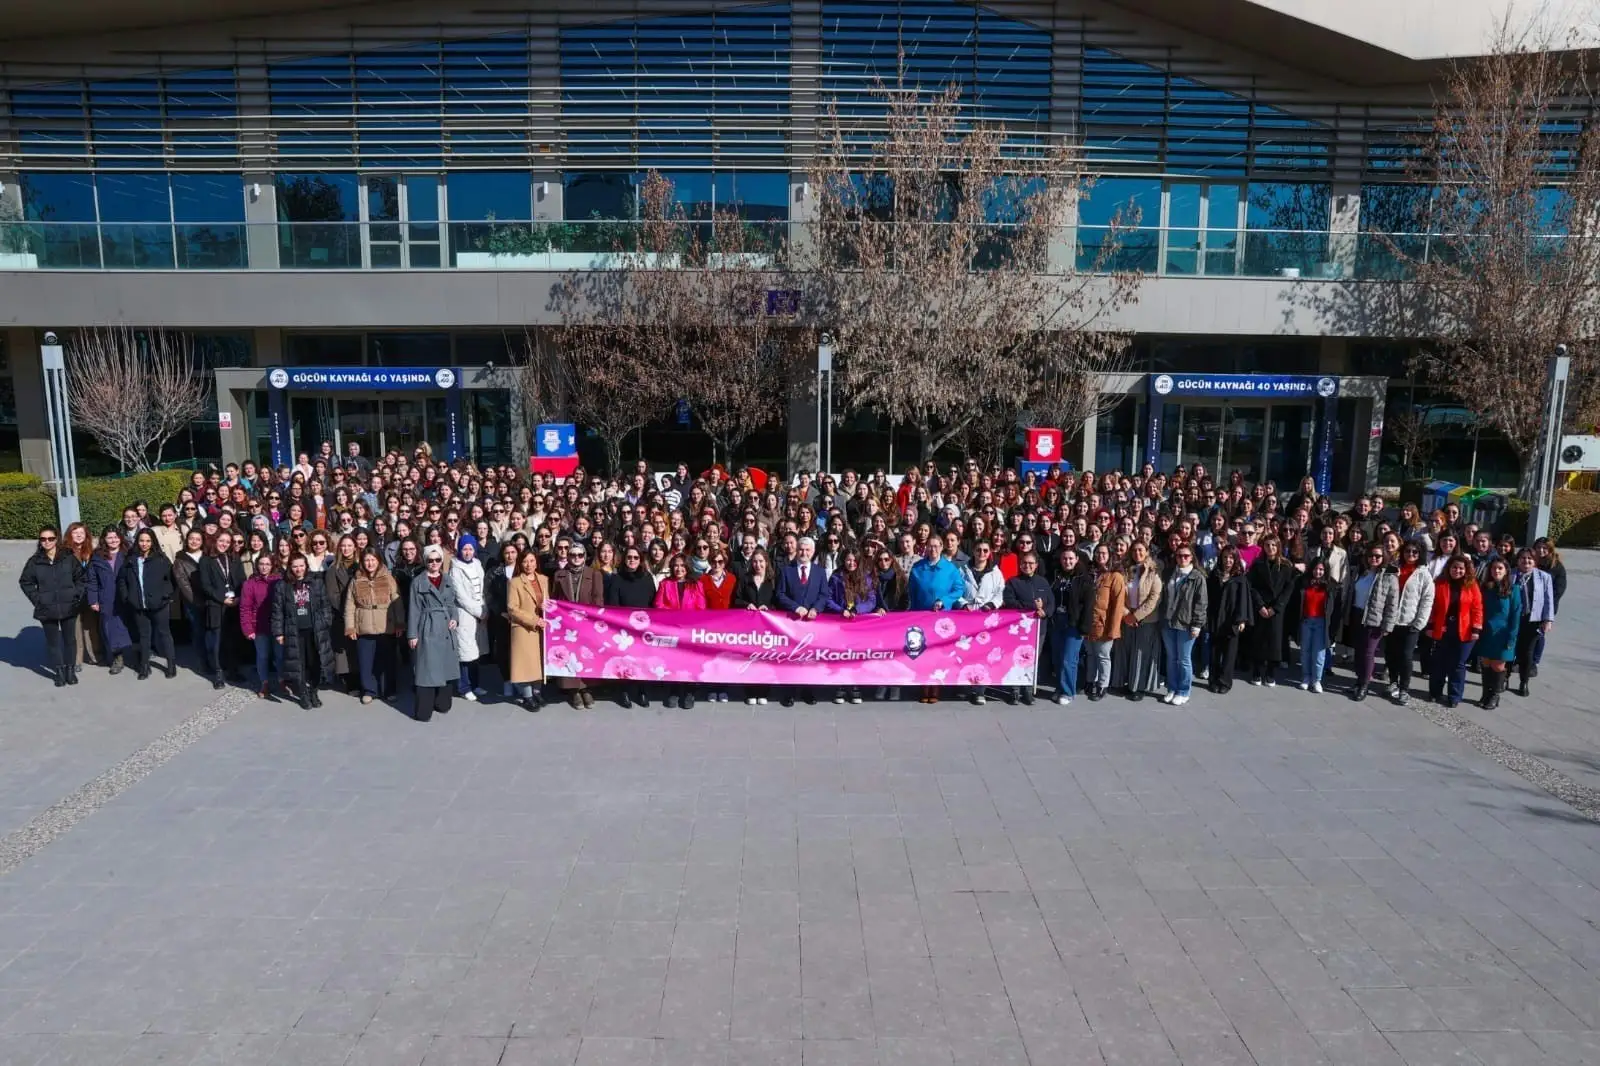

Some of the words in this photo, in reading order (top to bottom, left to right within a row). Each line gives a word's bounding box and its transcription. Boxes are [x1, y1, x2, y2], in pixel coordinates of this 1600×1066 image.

[293, 373, 327, 383] GÜCÜN
[330, 373, 371, 383] KAYNAĞI
[374, 374, 387, 383] 40
[390, 374, 431, 384] YAŞINDA
[1178, 379, 1211, 390] GÜCÜN
[1214, 381, 1254, 391] KAYNAĞI
[1257, 382, 1270, 391] 40
[1273, 383, 1313, 393] YAŞINDA
[691, 628, 789, 649] Havacılığın
[738, 632, 815, 674] güçlü
[815, 648, 895, 661] Kadınları
